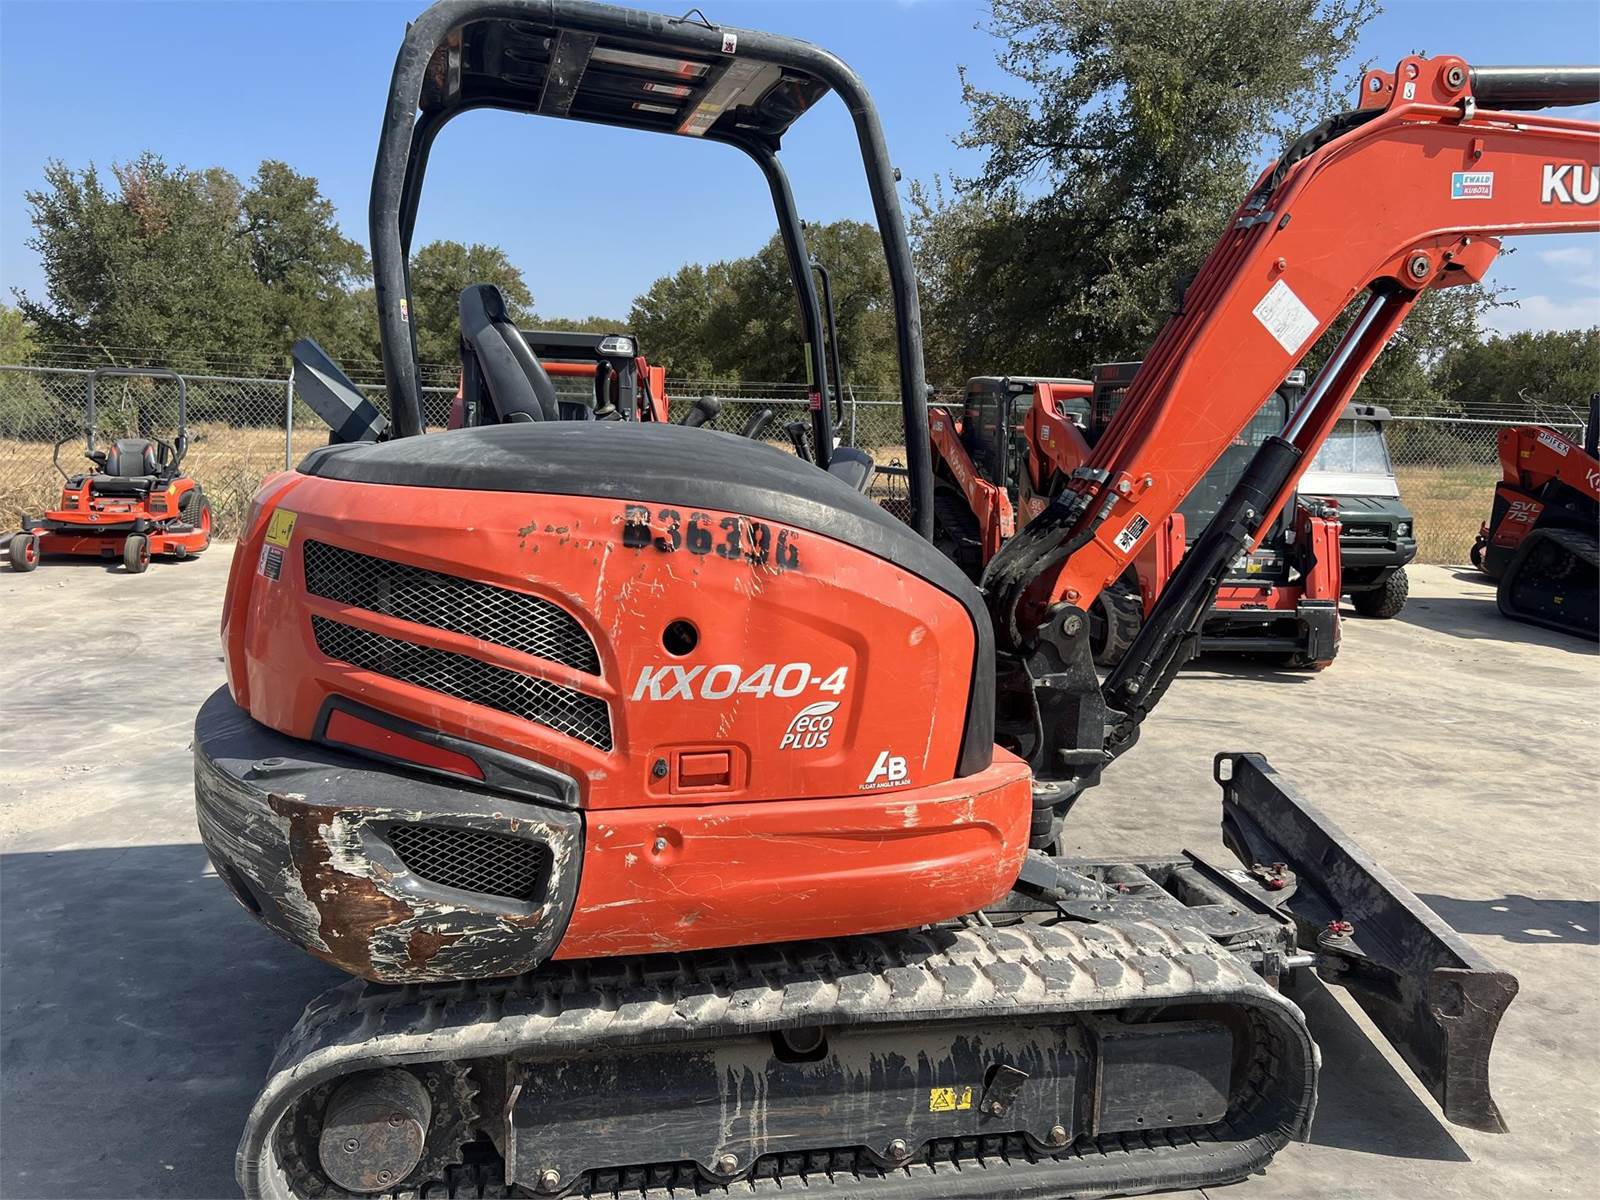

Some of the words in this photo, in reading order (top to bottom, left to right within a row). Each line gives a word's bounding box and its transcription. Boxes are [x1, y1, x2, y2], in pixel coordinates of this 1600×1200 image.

[1464, 176, 1491, 184] EWALD
[1541, 164, 1600, 204] KU
[1511, 501, 1540, 513] SVL
[631, 662, 849, 701] KX040-4
[779, 732, 830, 750] PLUS
